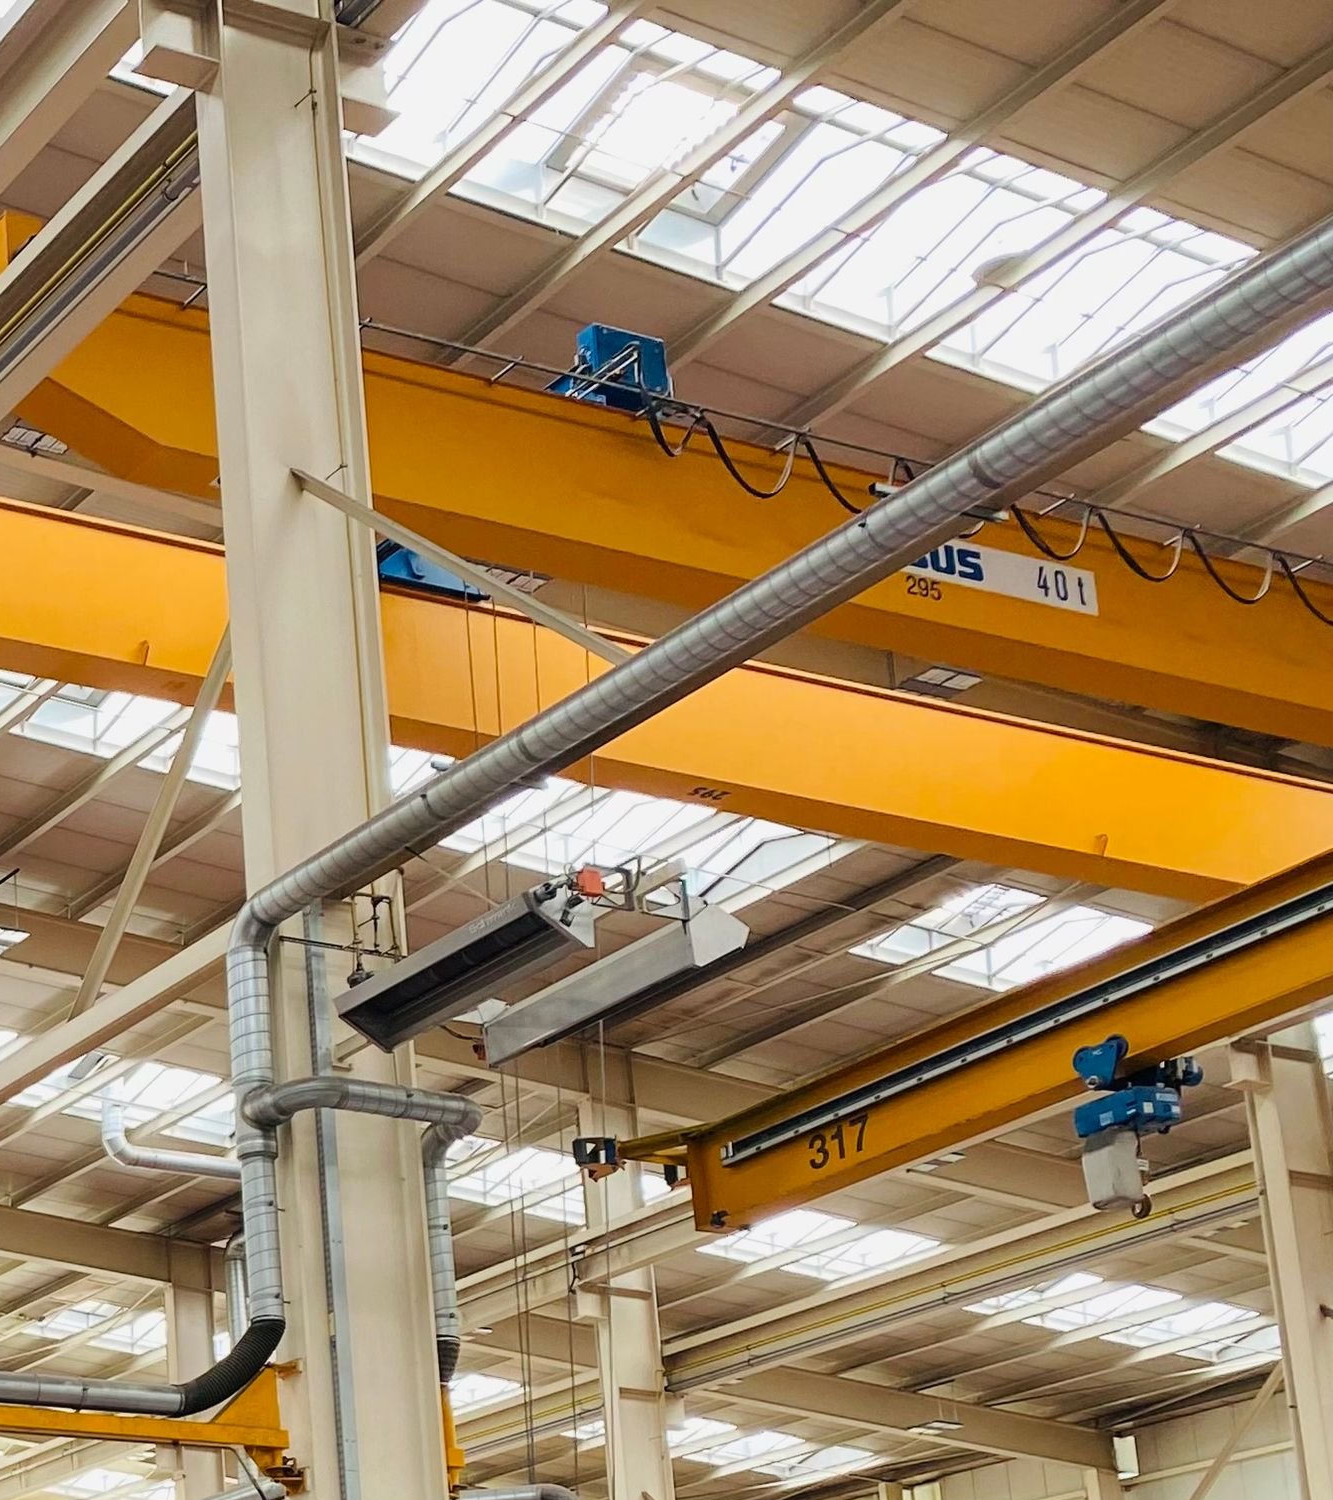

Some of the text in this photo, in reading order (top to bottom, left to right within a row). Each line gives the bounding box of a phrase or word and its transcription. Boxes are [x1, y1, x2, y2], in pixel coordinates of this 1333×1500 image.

[906, 575, 942, 601] 295
[909, 545, 984, 582] US
[1037, 566, 1068, 601] 40
[808, 1112, 869, 1170] 317
